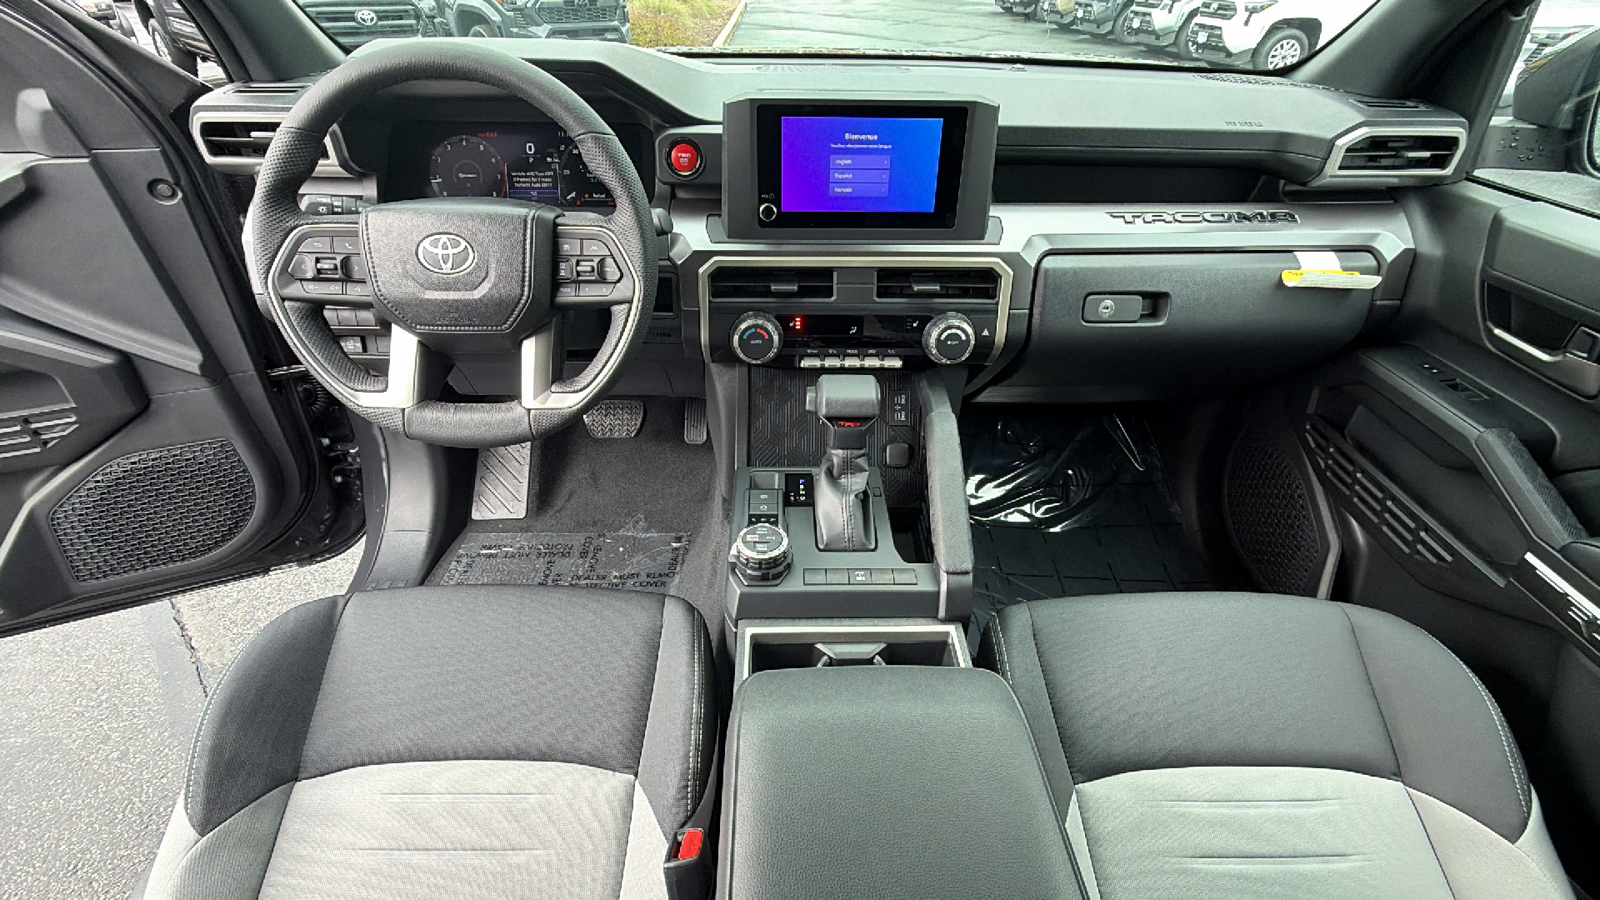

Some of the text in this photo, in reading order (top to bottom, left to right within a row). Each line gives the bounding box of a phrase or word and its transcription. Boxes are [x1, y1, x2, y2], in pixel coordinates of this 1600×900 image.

[526, 143, 535, 154] 0
[1104, 209, 1300, 224] TACOMA
[457, 551, 499, 559] REMOVE
[571, 571, 676, 582] DEALER MUST REMO
[633, 580, 667, 588] COVER
